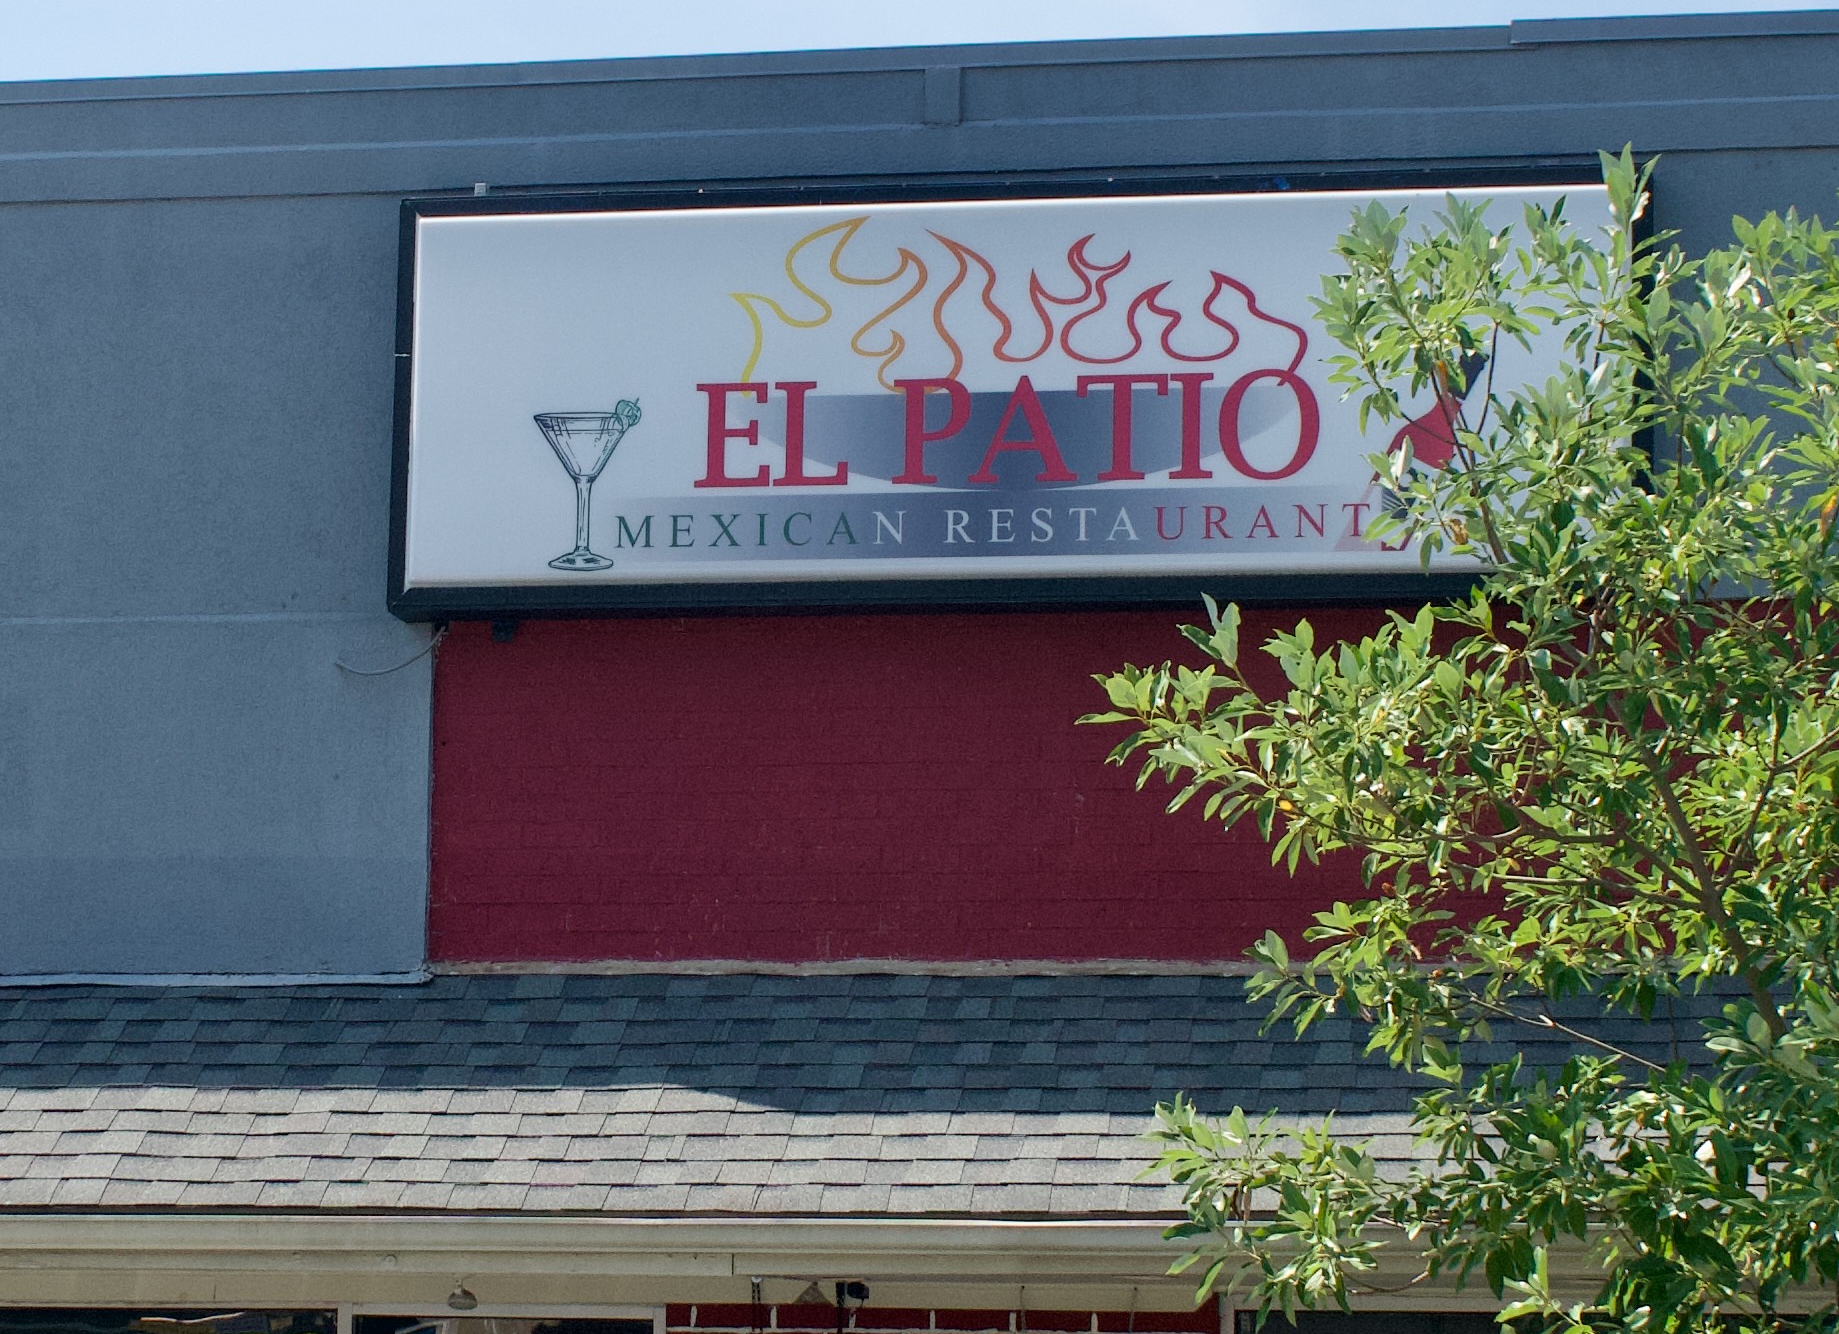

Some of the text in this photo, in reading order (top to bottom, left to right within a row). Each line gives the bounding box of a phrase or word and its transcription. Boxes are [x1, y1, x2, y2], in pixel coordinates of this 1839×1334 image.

[693, 367, 1320, 488] EL PATIO
[614, 503, 1372, 548] MEXICAN RESTAURANT
